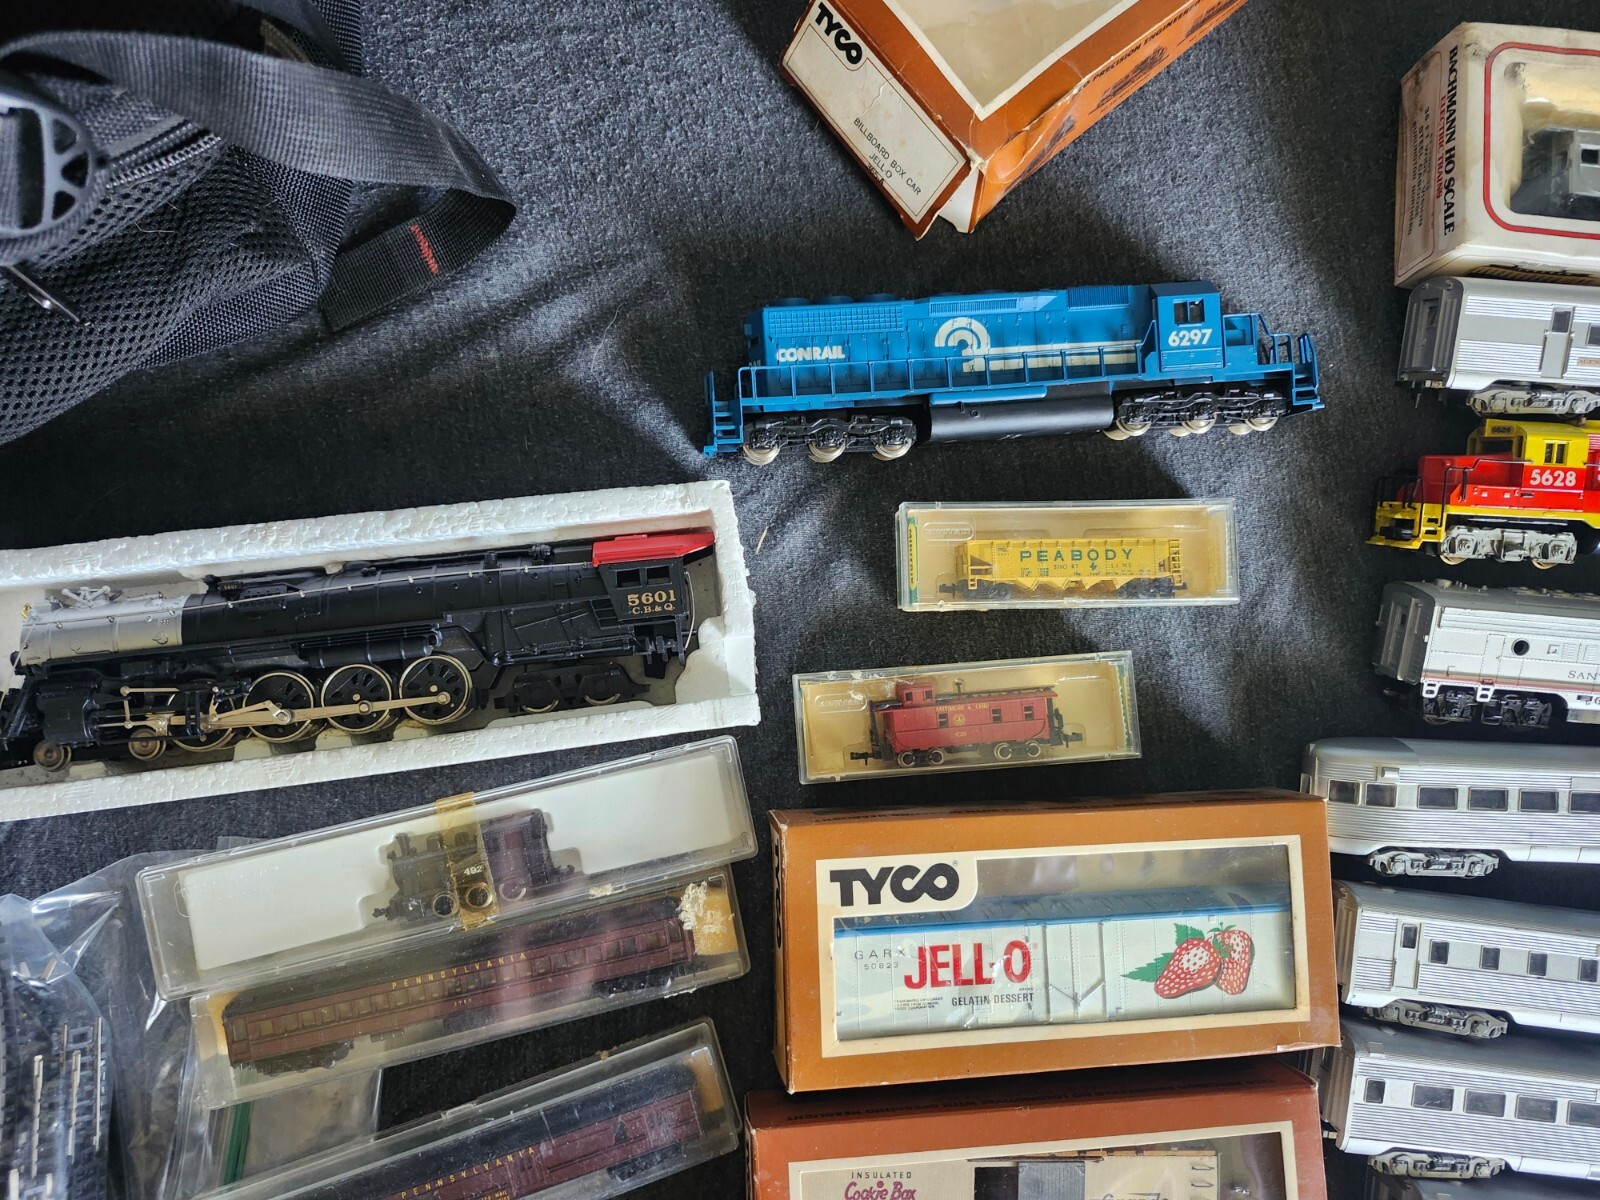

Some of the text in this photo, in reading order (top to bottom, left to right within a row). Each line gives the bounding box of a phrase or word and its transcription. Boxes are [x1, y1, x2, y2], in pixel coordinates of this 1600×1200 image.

[815, 2, 863, 65] TYCO
[1092, 43, 1142, 82] PRECISION
[1436, 96, 1446, 199] ELECTRIC TRAINS
[1443, 45, 1459, 236] BACHMANN HO SCALE
[853, 117, 922, 196] BILLBOARD BOX CAR
[868, 153, 893, 179] JELL-O
[1167, 328, 1213, 348] 6297
[776, 346, 846, 362] CONRAIL
[1529, 468, 1577, 487] 5628
[1019, 548, 1133, 562] PEABODY
[627, 589, 677, 607] 5601
[1567, 670, 1600, 681] SAN
[463, 863, 484, 877] 492
[829, 862, 960, 907] TYCO
[854, 948, 907, 961] GARX
[903, 939, 1032, 990] JELL-O
[390, 951, 529, 989] PENNSYLVANIA
[864, 962, 899, 971] 50823
[951, 992, 1035, 1007] GELATIN DESSERT
[787, 1110, 862, 1121] HEADLIGHT
[400, 1147, 536, 1199] PENNSYLVANIA
[851, 1171, 912, 1179] INSULATED
[844, 1180, 917, 1200] Cookie Box
